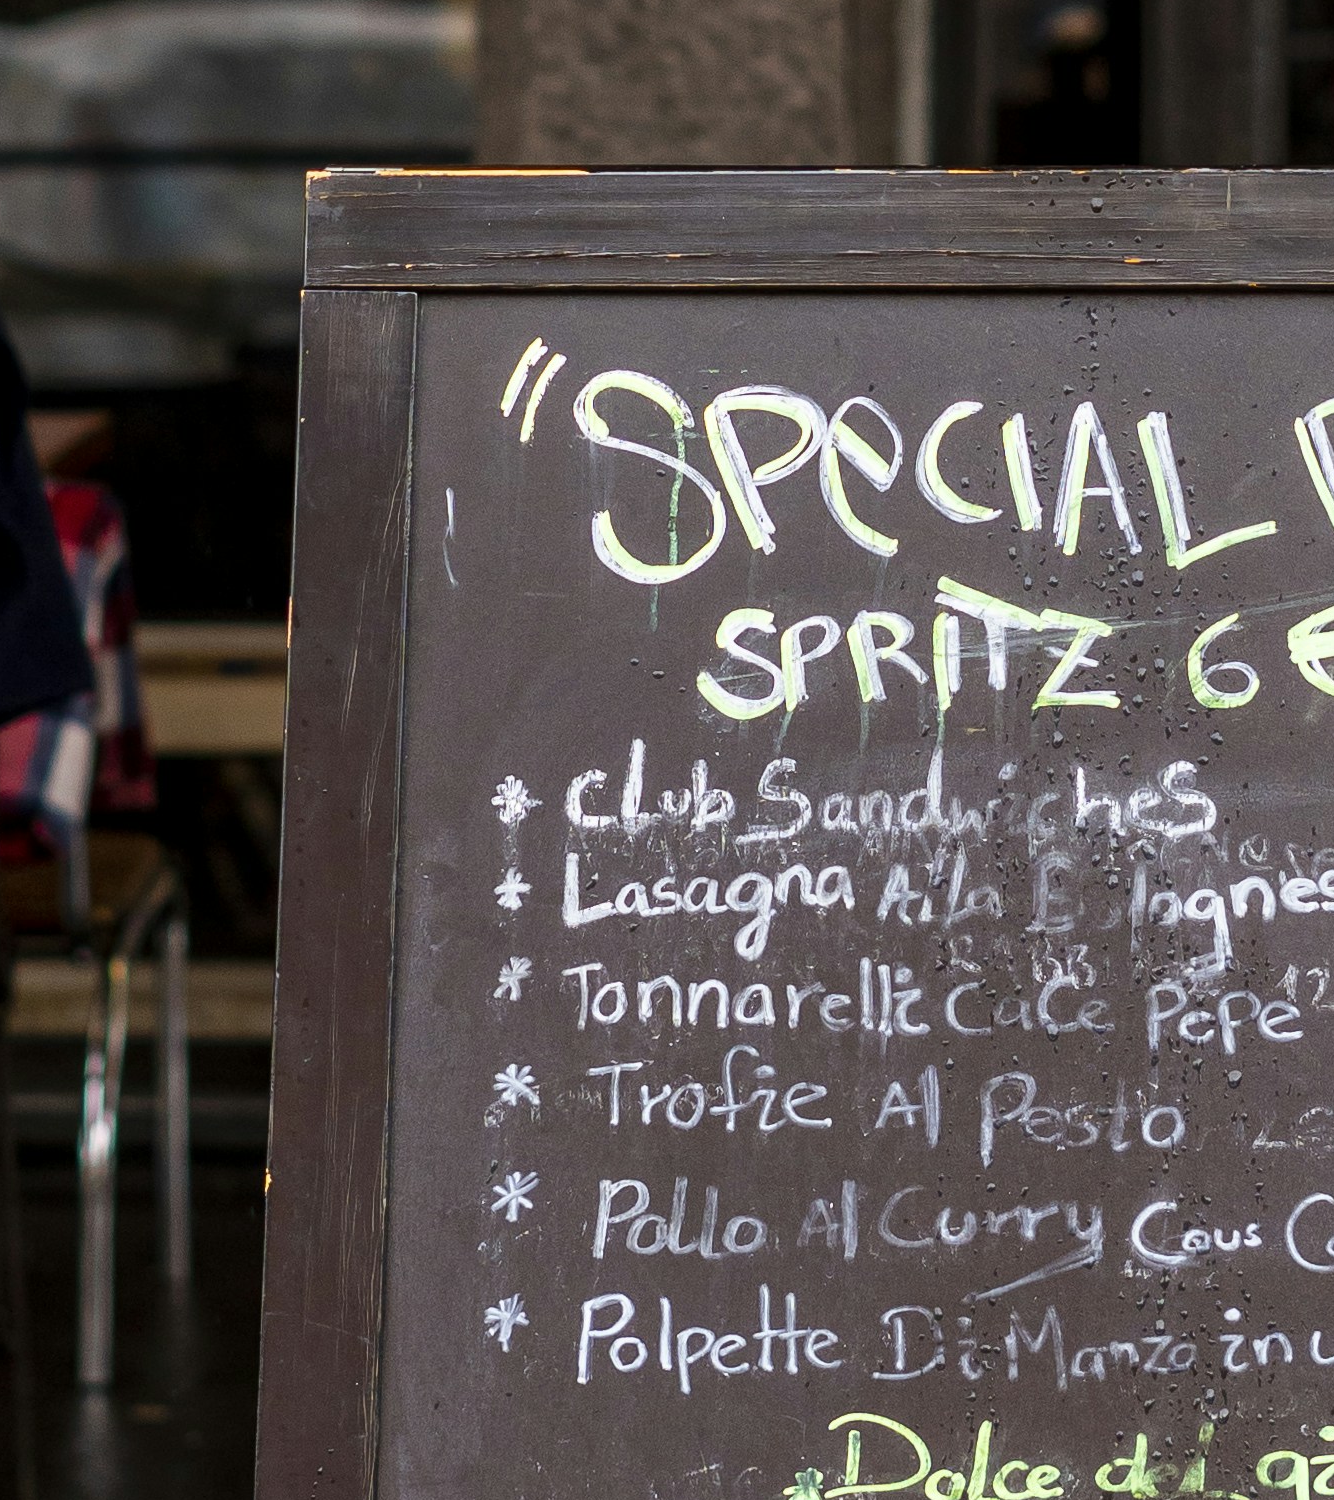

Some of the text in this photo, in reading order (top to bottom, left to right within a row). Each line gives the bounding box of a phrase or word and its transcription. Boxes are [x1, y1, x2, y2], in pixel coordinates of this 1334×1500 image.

[695, 576, 1122, 720] SPRITZ
[562, 852, 856, 962] Lasagna
[586, 1044, 833, 1133] Trofie
[875, 1065, 940, 1147] Al
[979, 1070, 1187, 1168] Pesto
[592, 1177, 769, 1260] Pollo
[797, 1179, 858, 1260] Al
[877, 1185, 1105, 1301] Curry
[1129, 1200, 1262, 1267] Cous
[576, 1282, 845, 1394] Polpette
[1220, 1307, 1293, 1373] in
